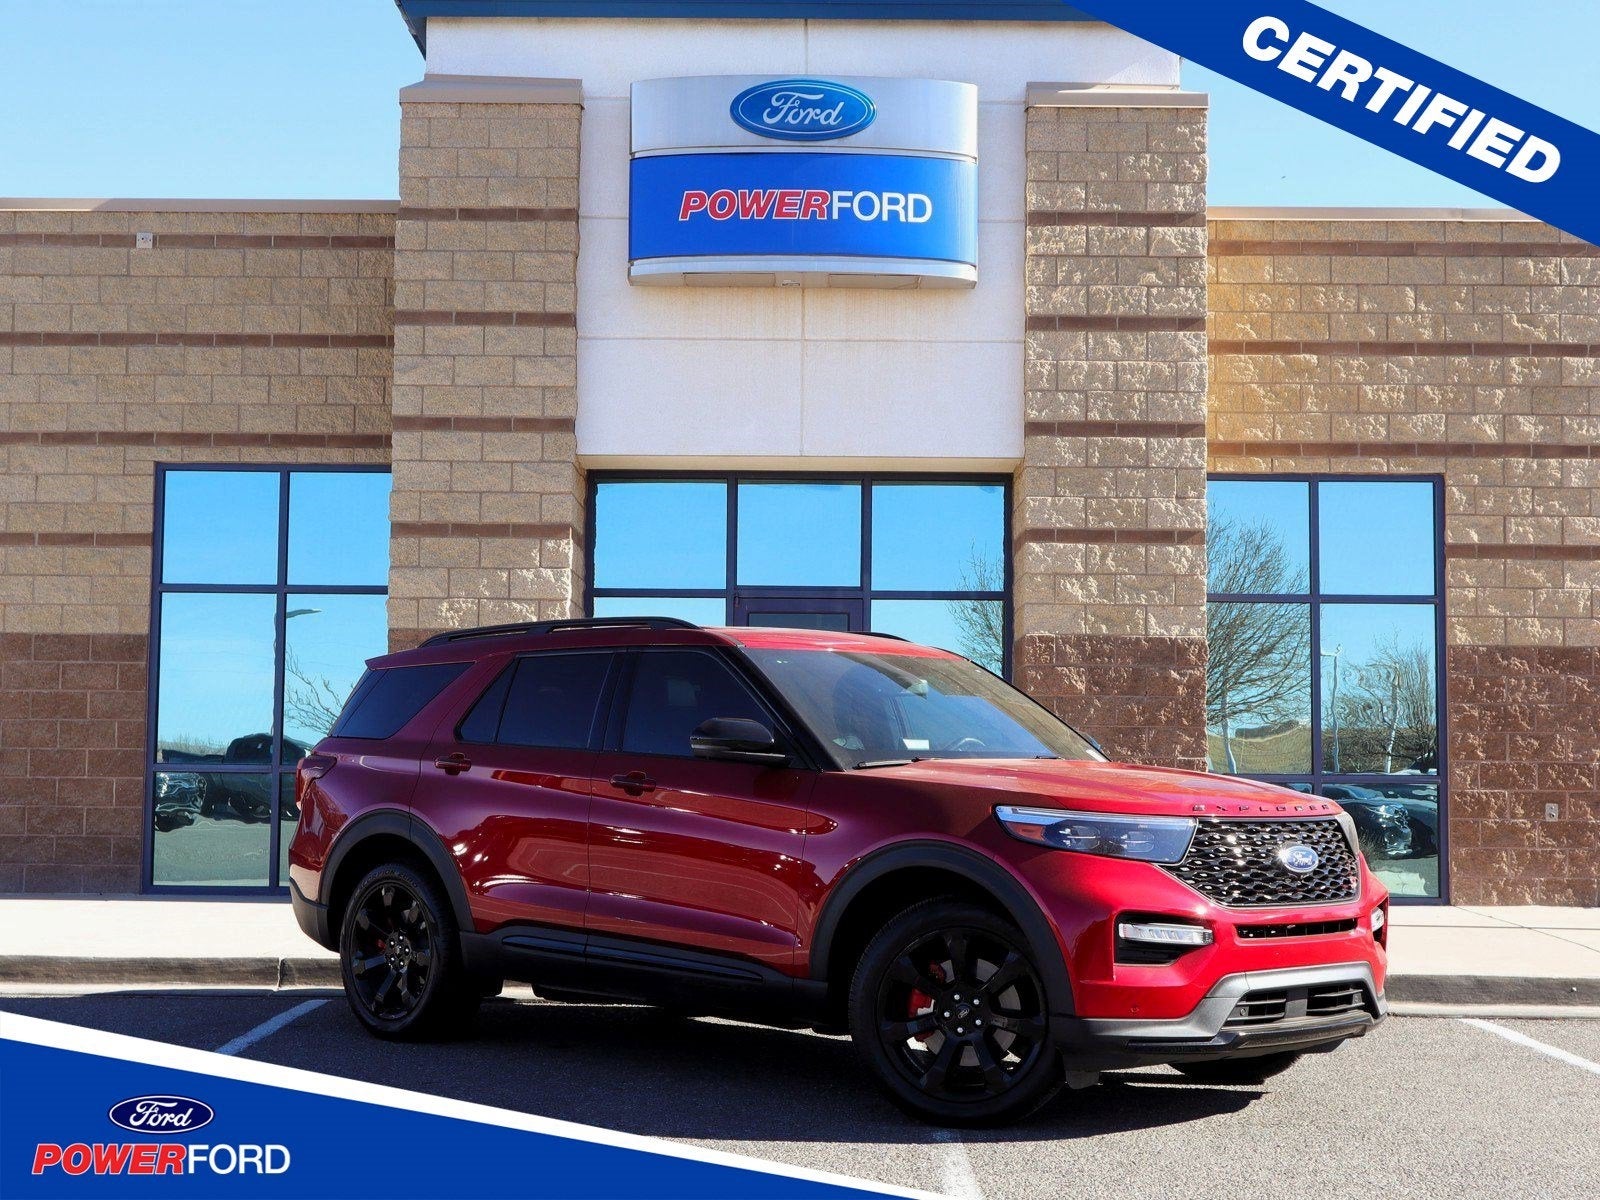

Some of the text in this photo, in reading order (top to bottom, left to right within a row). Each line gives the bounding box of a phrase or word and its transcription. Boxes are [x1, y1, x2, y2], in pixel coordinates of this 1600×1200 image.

[763, 91, 843, 126] Ford
[678, 189, 932, 223] POWERFORD
[1192, 804, 1329, 812] EXPLORER
